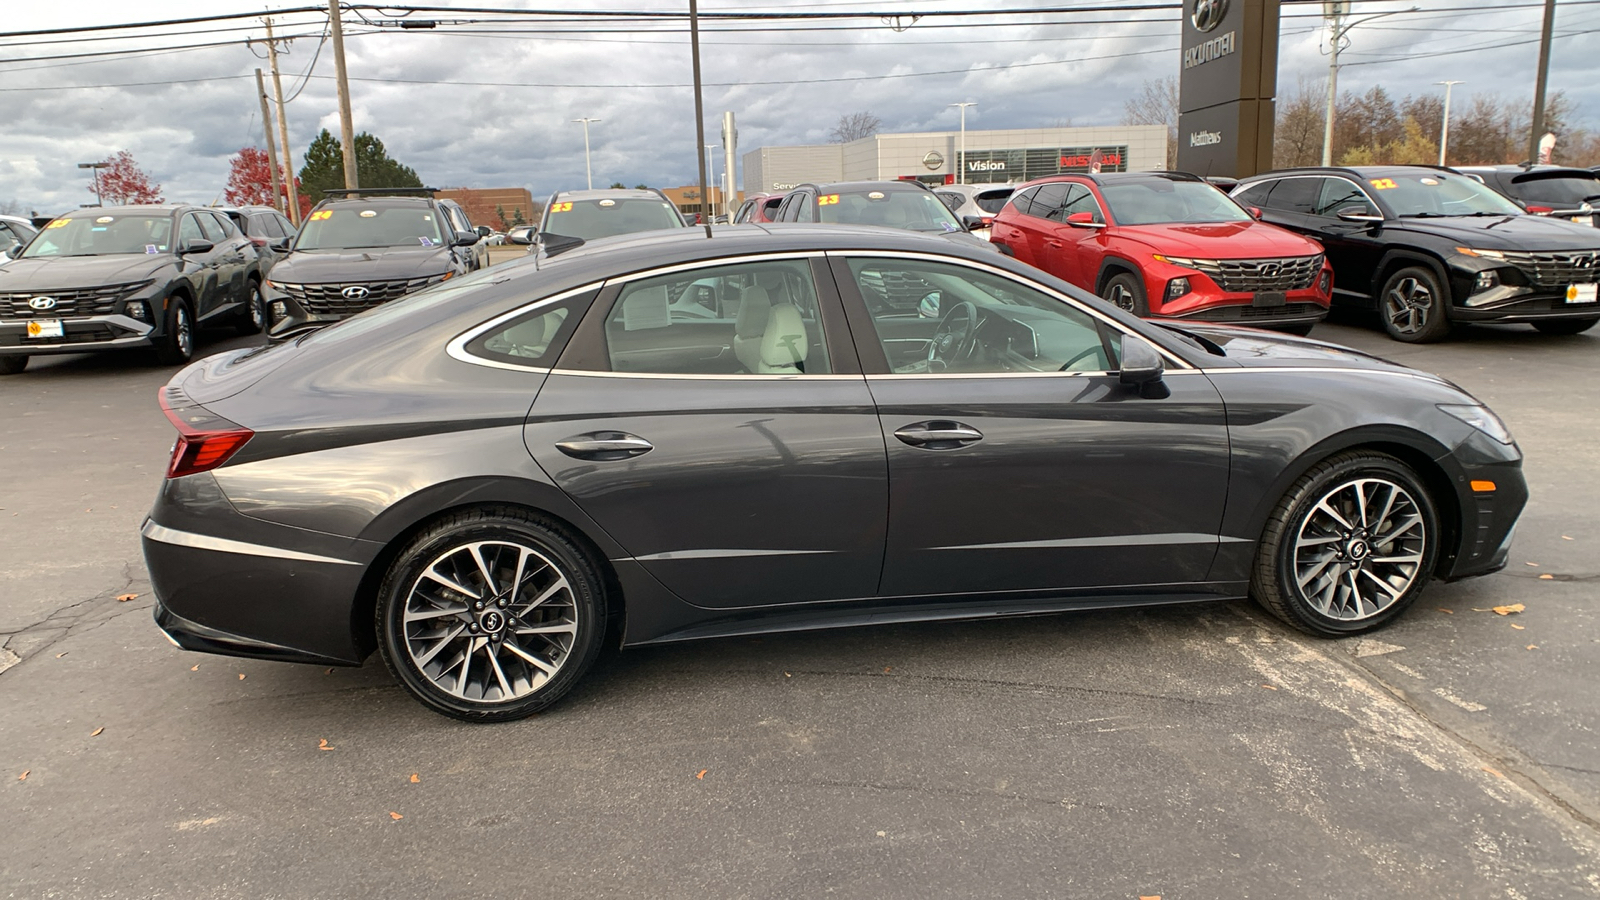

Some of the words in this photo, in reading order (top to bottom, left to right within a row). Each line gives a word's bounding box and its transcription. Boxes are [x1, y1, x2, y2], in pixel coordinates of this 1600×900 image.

[1184, 31, 1235, 69] HYUNDAI
[1190, 130, 1221, 147] Matthews
[969, 160, 1005, 171] Vision
[1370, 178, 1397, 190] 22
[818, 194, 839, 206] 23
[550, 202, 574, 213] 23
[310, 210, 334, 221] 24
